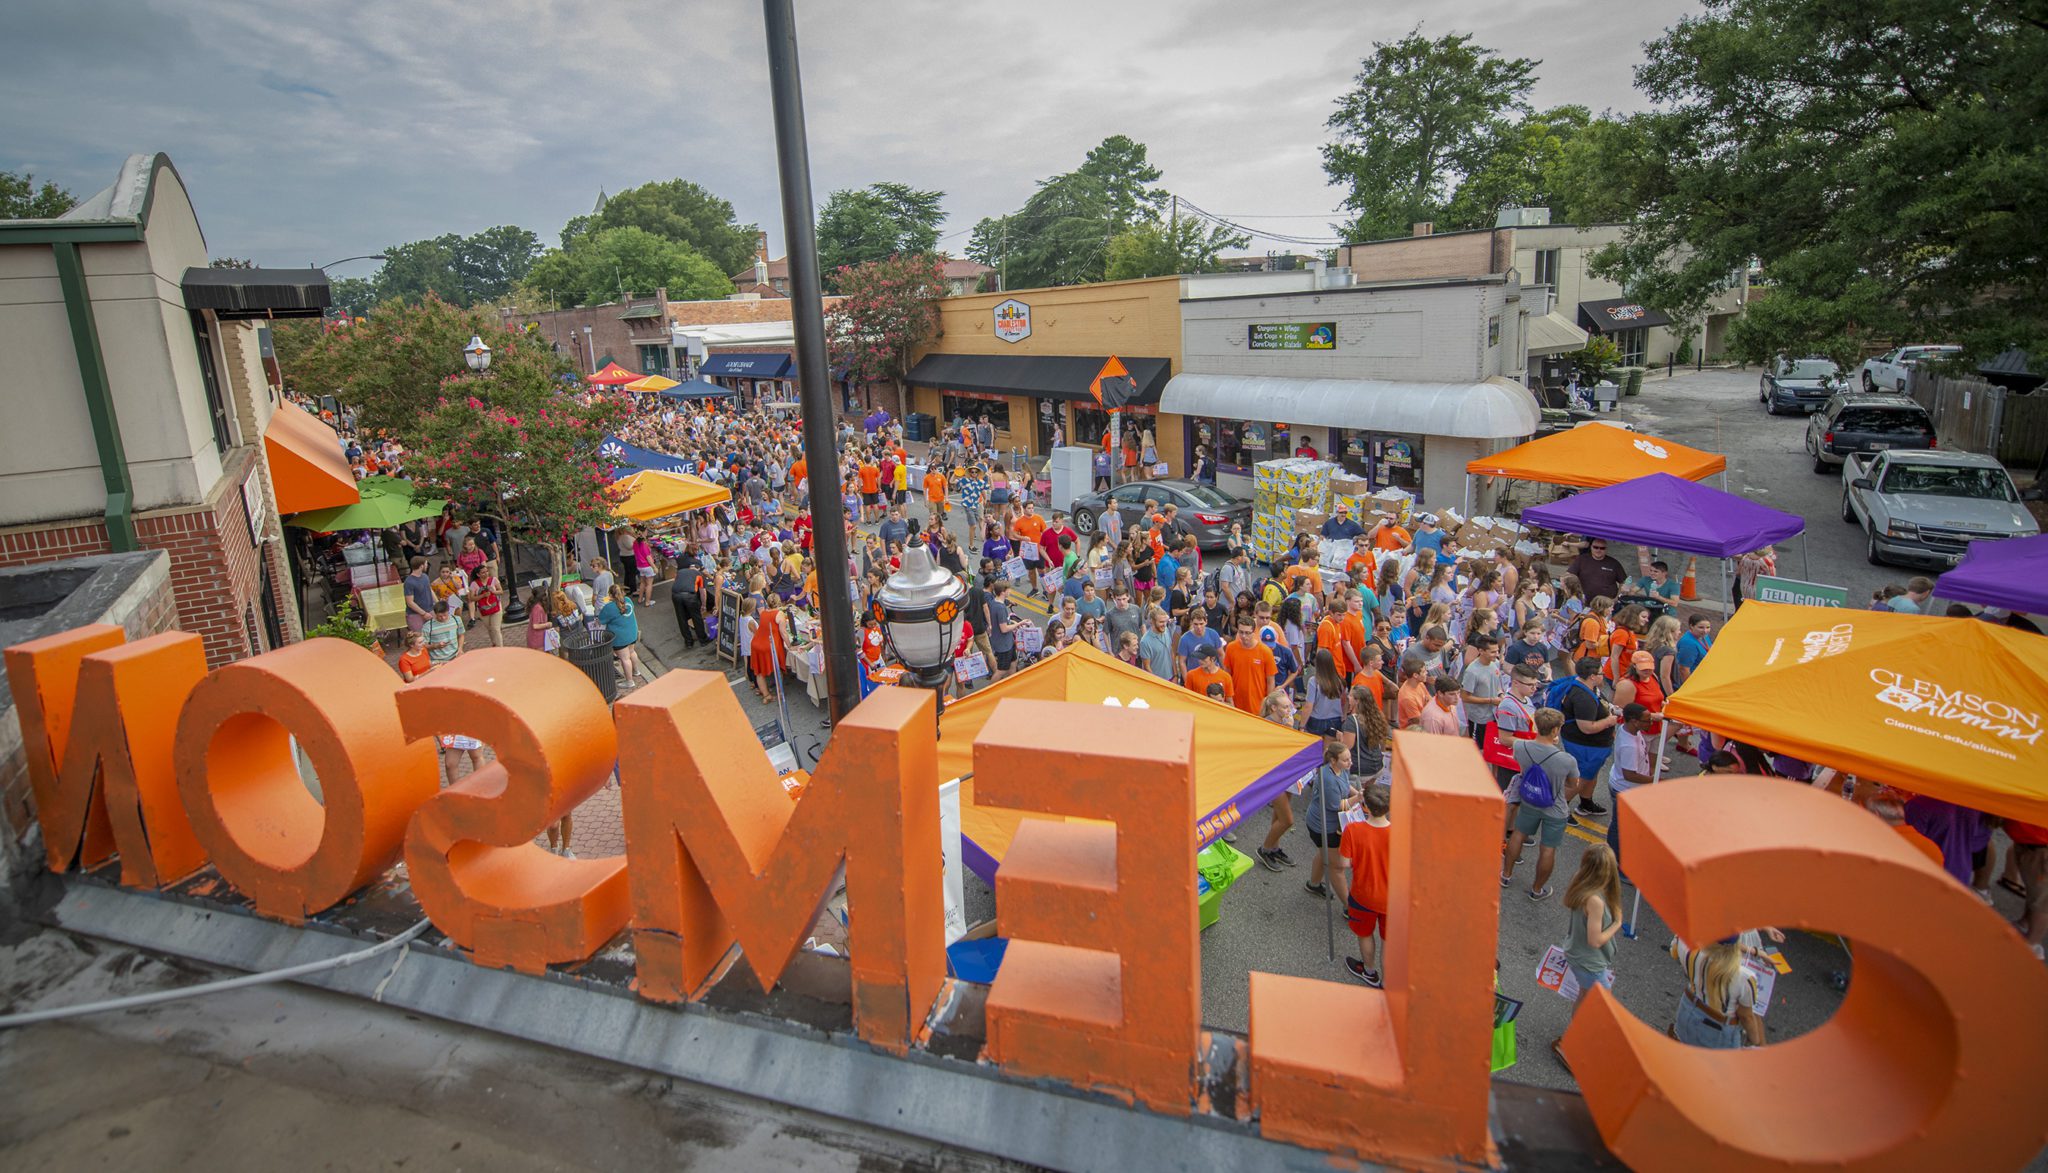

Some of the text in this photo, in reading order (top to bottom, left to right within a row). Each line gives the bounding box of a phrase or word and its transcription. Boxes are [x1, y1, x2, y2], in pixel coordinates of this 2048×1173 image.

[1766, 589, 1791, 602] TELL
[1870, 668, 2041, 729] CLEMSON
[1884, 717, 2017, 761] Clemson.edu/alumni
[1912, 699, 2044, 746] Alumni
